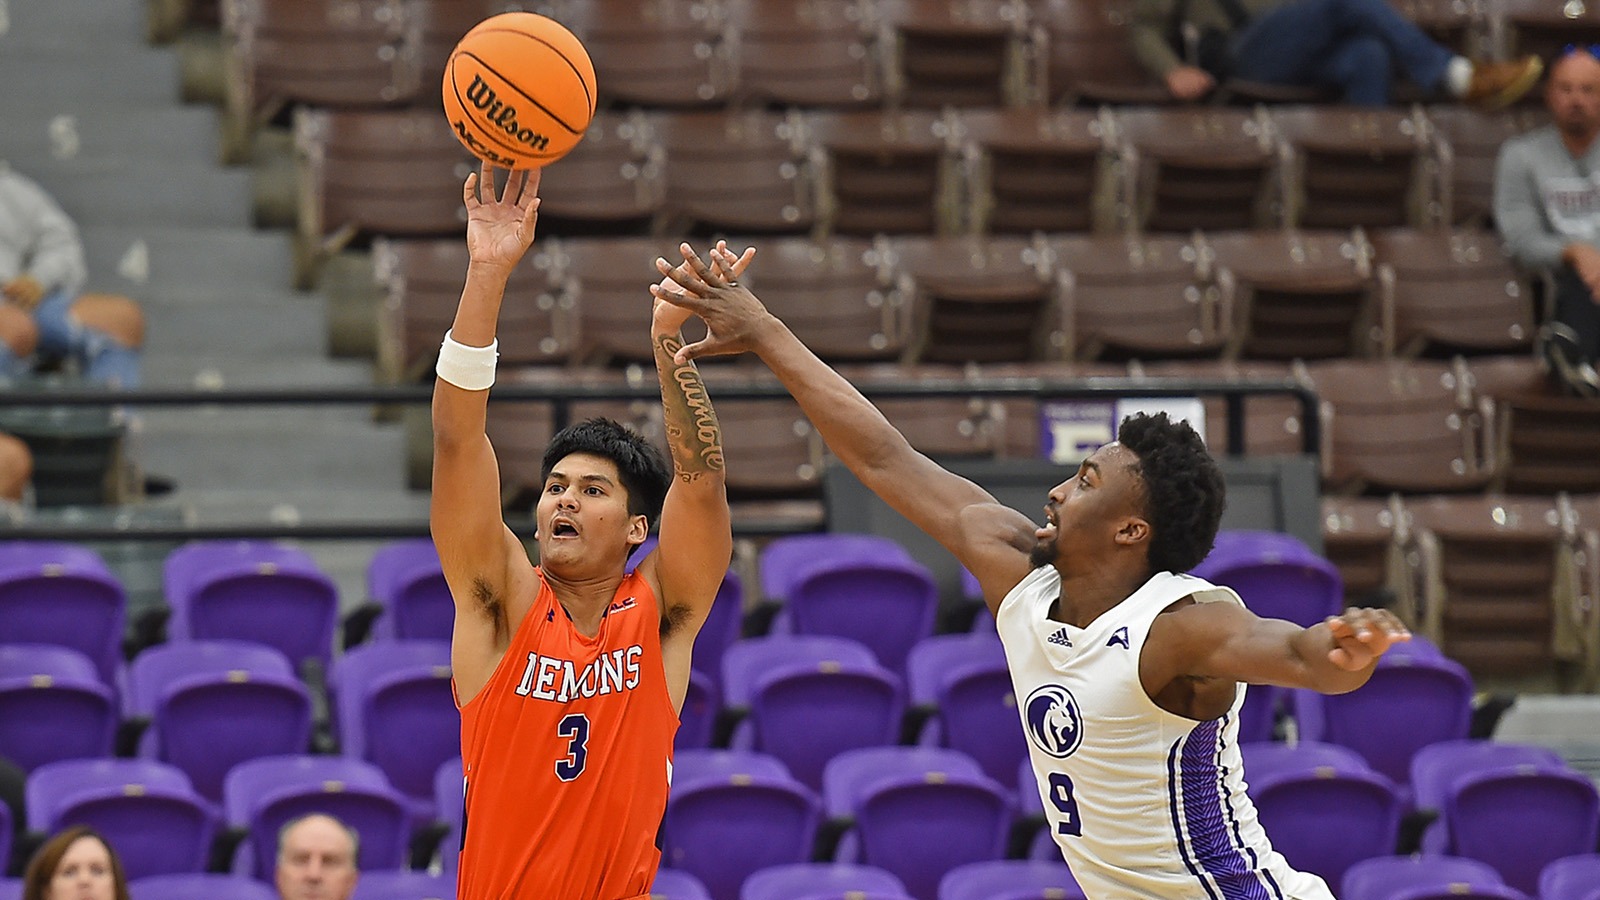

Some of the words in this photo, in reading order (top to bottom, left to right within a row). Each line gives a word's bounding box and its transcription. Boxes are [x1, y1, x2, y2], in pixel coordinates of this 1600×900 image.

[466, 72, 550, 151] Wilson
[454, 120, 516, 167] NCAA
[513, 644, 643, 703] DEMONS
[1047, 636, 1073, 648] adidas
[555, 713, 590, 782] 3
[1047, 771, 1083, 838] 9
